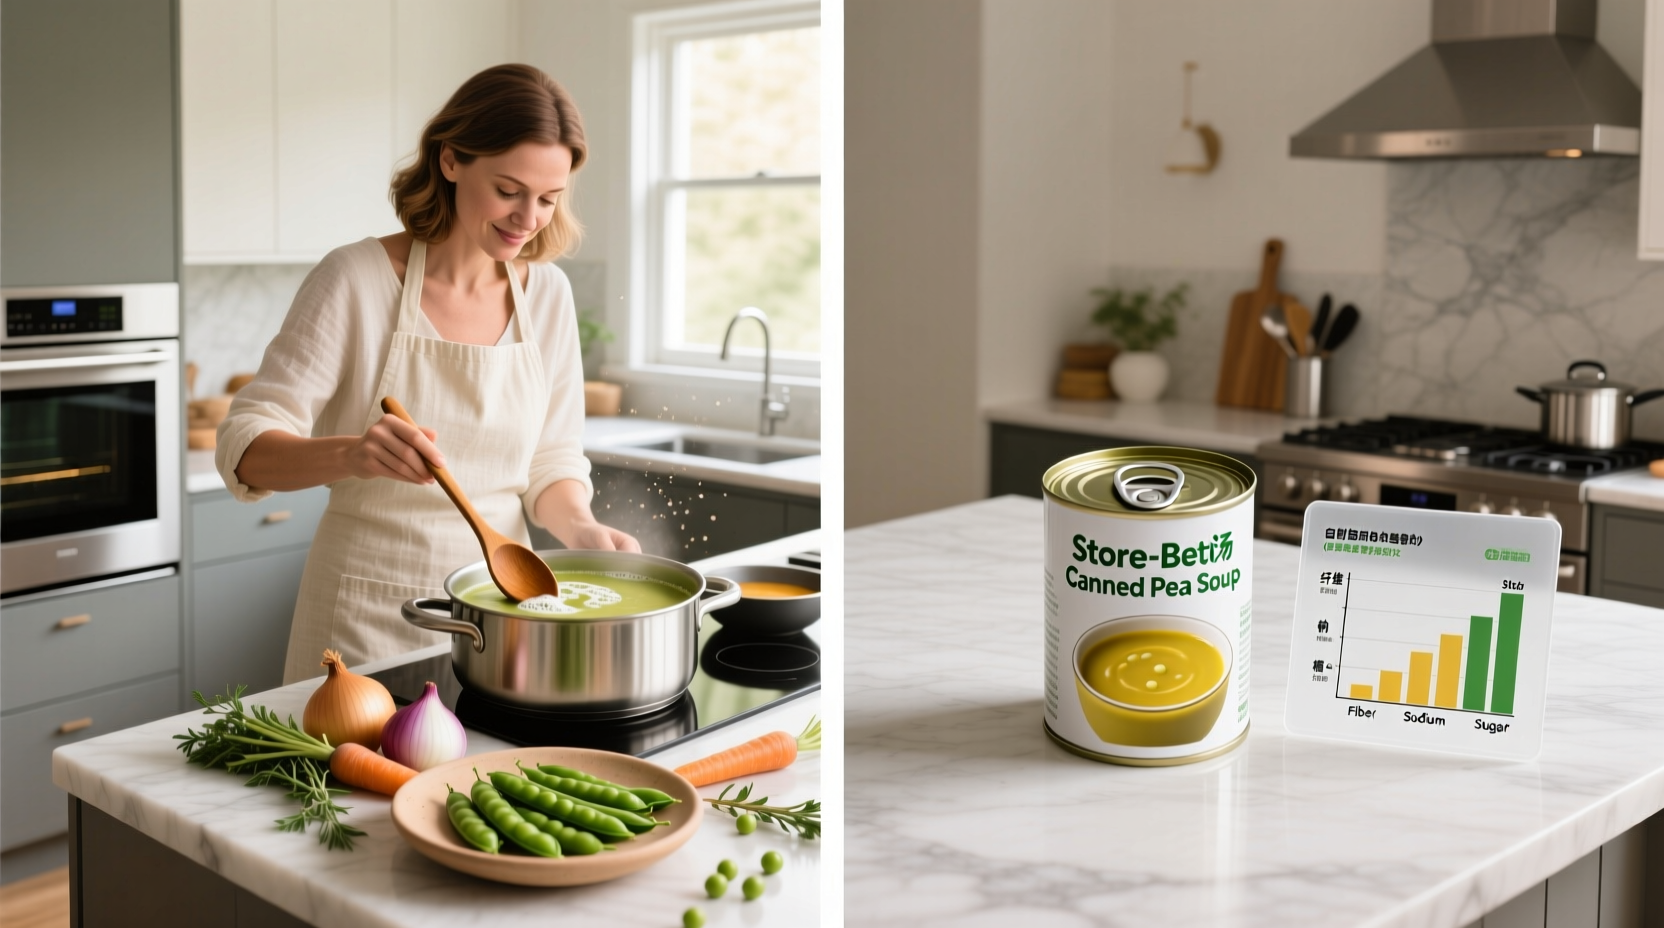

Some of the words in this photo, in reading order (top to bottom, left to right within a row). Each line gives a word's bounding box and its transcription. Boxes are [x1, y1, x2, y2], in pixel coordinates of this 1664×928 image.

[1065, 565, 1145, 598] Canned
[1151, 576, 1192, 598] Pea
[1197, 567, 1241, 593] Soup
[1474, 718, 1510, 734] Sugar
